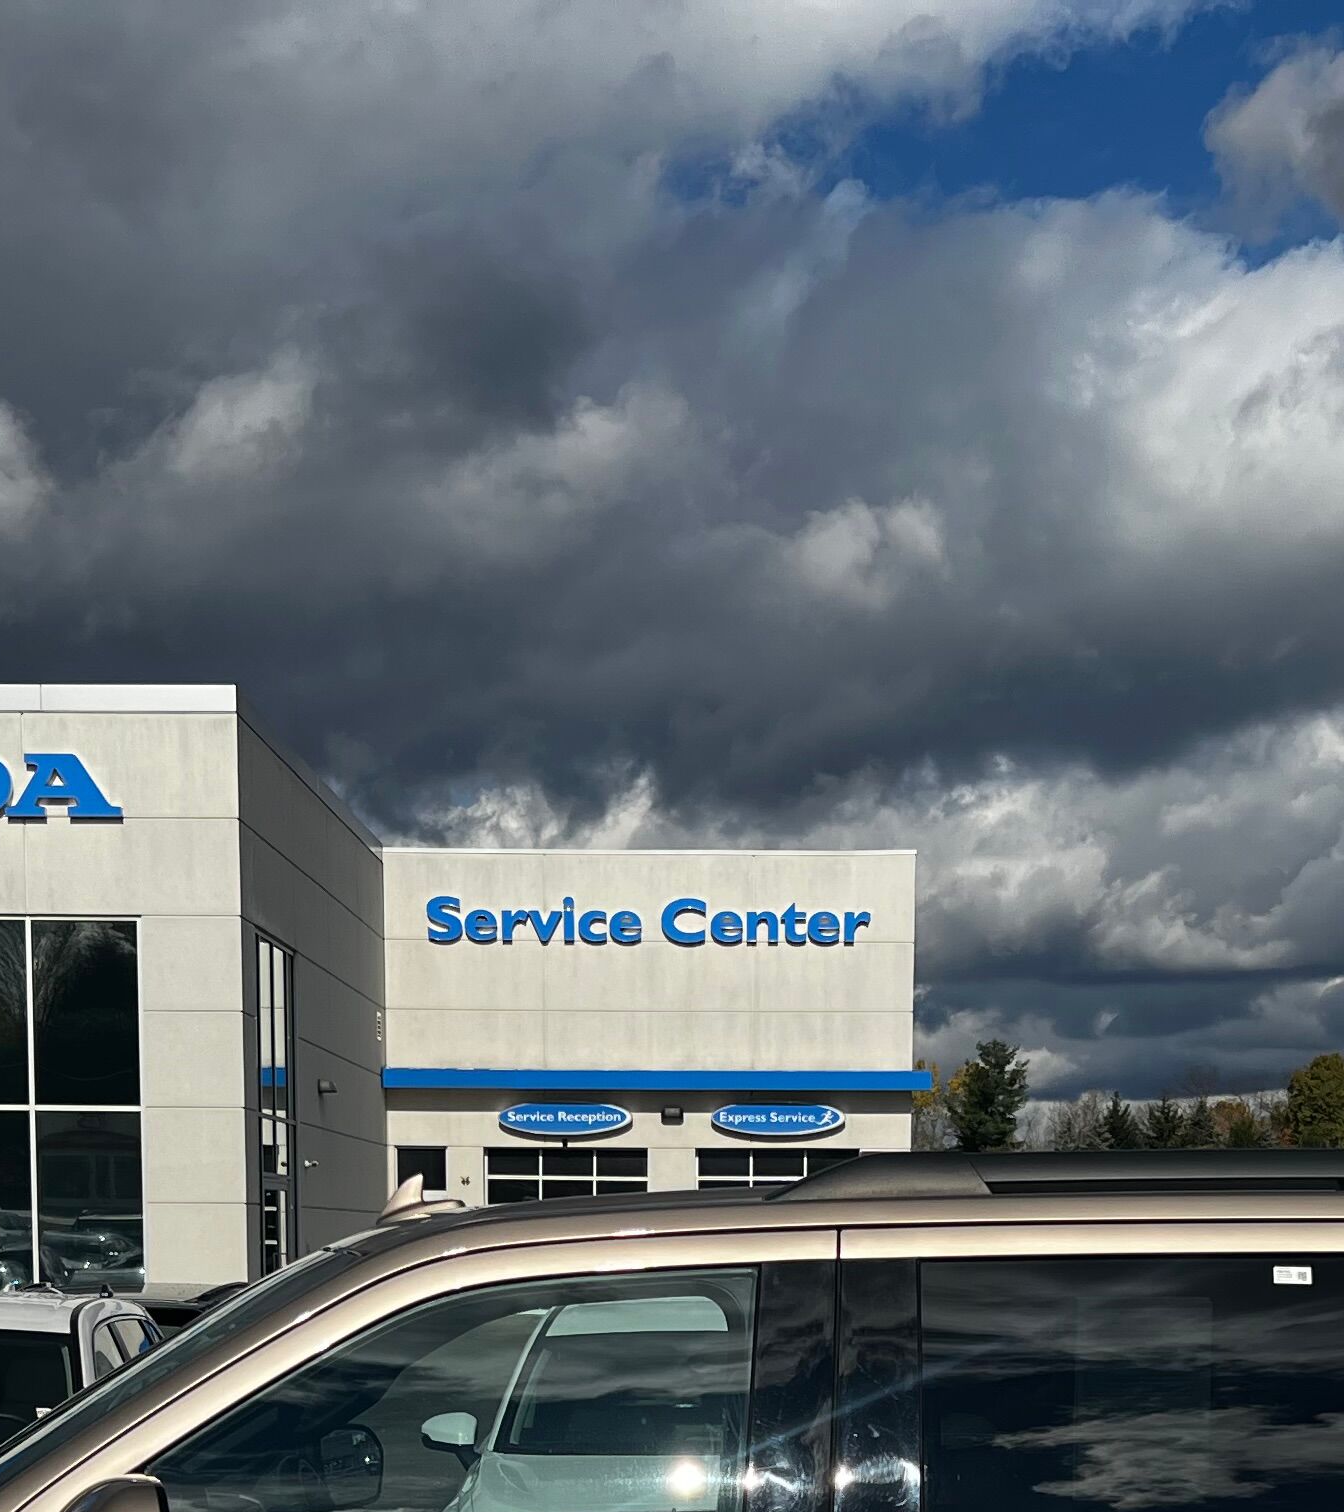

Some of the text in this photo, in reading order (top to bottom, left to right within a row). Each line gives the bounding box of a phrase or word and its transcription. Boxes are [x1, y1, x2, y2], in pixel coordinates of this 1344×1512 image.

[426, 896, 871, 945] Service Center
[507, 1110, 622, 1126] Service Reception
[719, 1111, 816, 1126] Express Service
